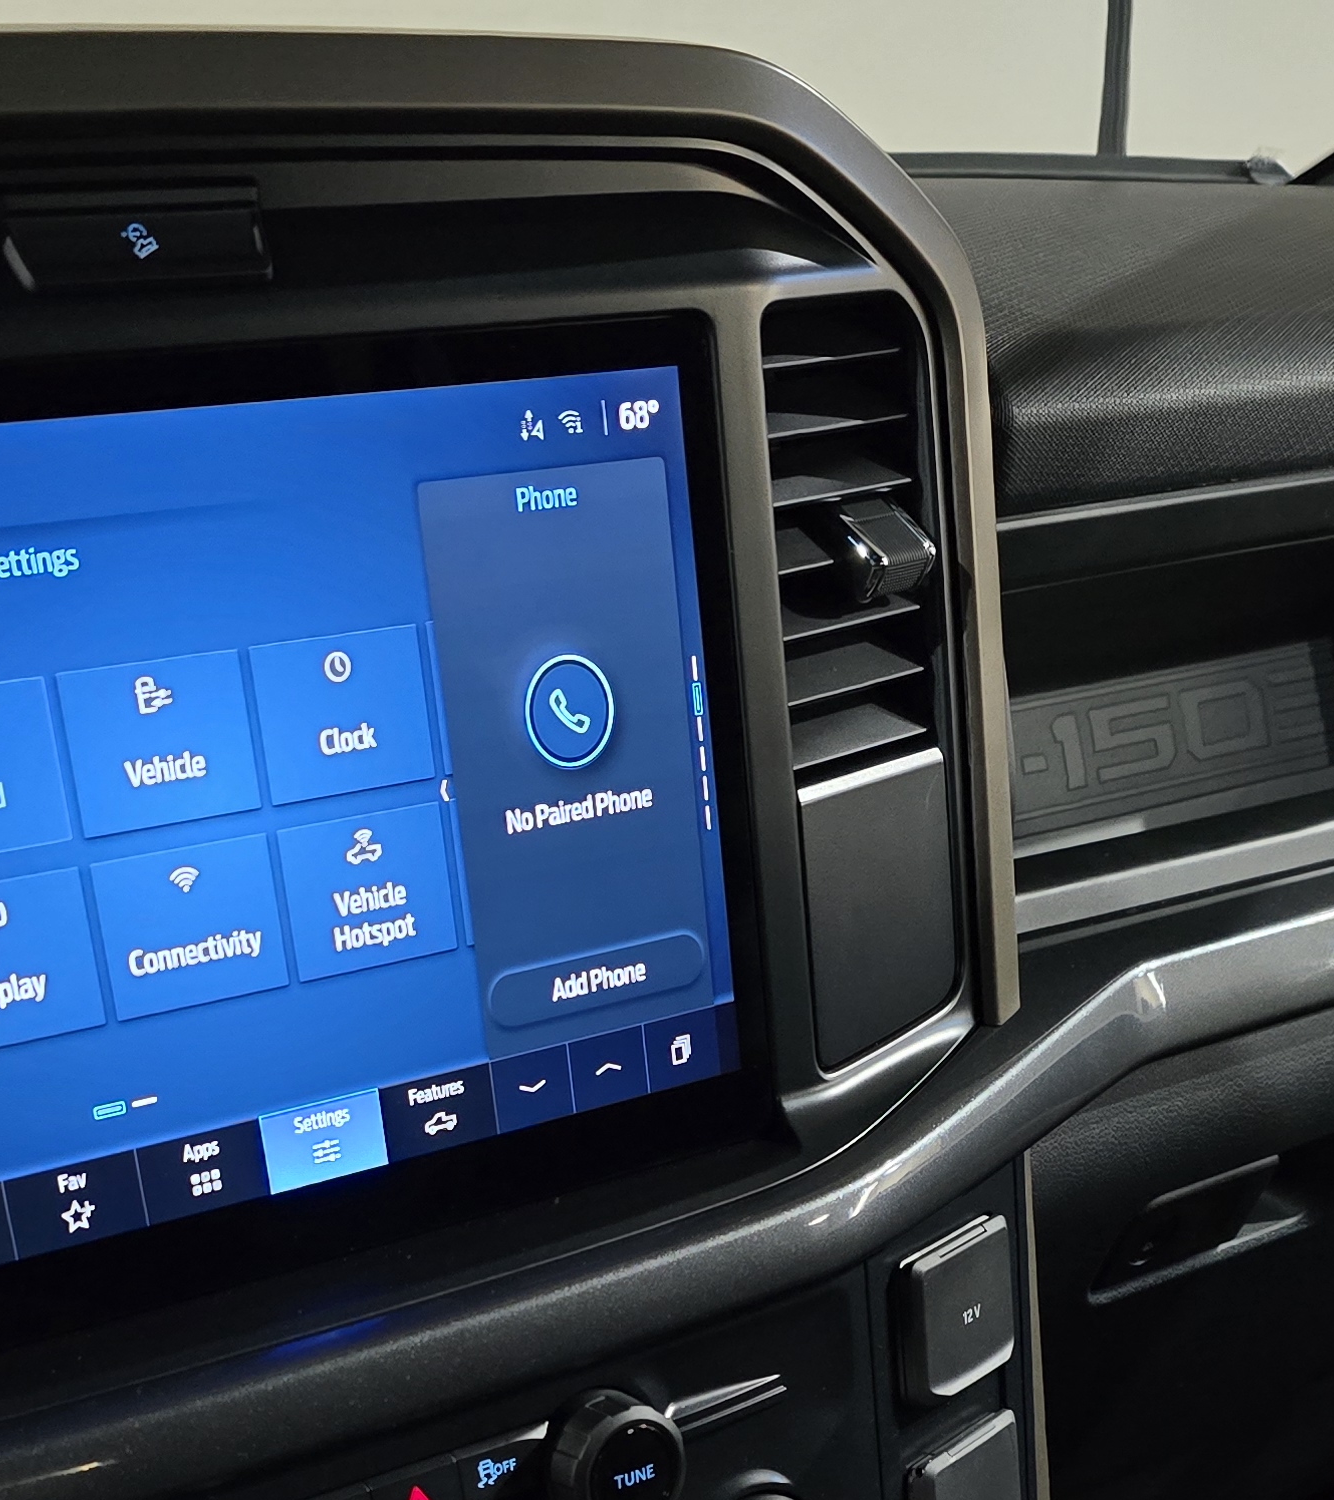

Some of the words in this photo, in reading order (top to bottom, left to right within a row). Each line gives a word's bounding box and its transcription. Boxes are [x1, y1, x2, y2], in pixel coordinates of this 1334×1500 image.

[515, 485, 578, 513] Phone
[319, 722, 378, 756] Clock
[123, 750, 207, 788] Vehicle
[505, 807, 534, 835] No
[535, 794, 595, 829] Paired
[594, 787, 653, 816] Phone
[332, 882, 407, 918] Vehicle
[333, 913, 417, 953] Hotspot
[127, 928, 263, 978] Connectivity
[551, 969, 590, 1003] Add
[590, 961, 647, 995] Phone
[407, 1079, 465, 1106] Features
[293, 1107, 351, 1135] Settings
[182, 1138, 221, 1165] Apps
[56, 1170, 88, 1194] Fav
[493, 1457, 517, 1477] OFF
[614, 1463, 656, 1490] TUNE
